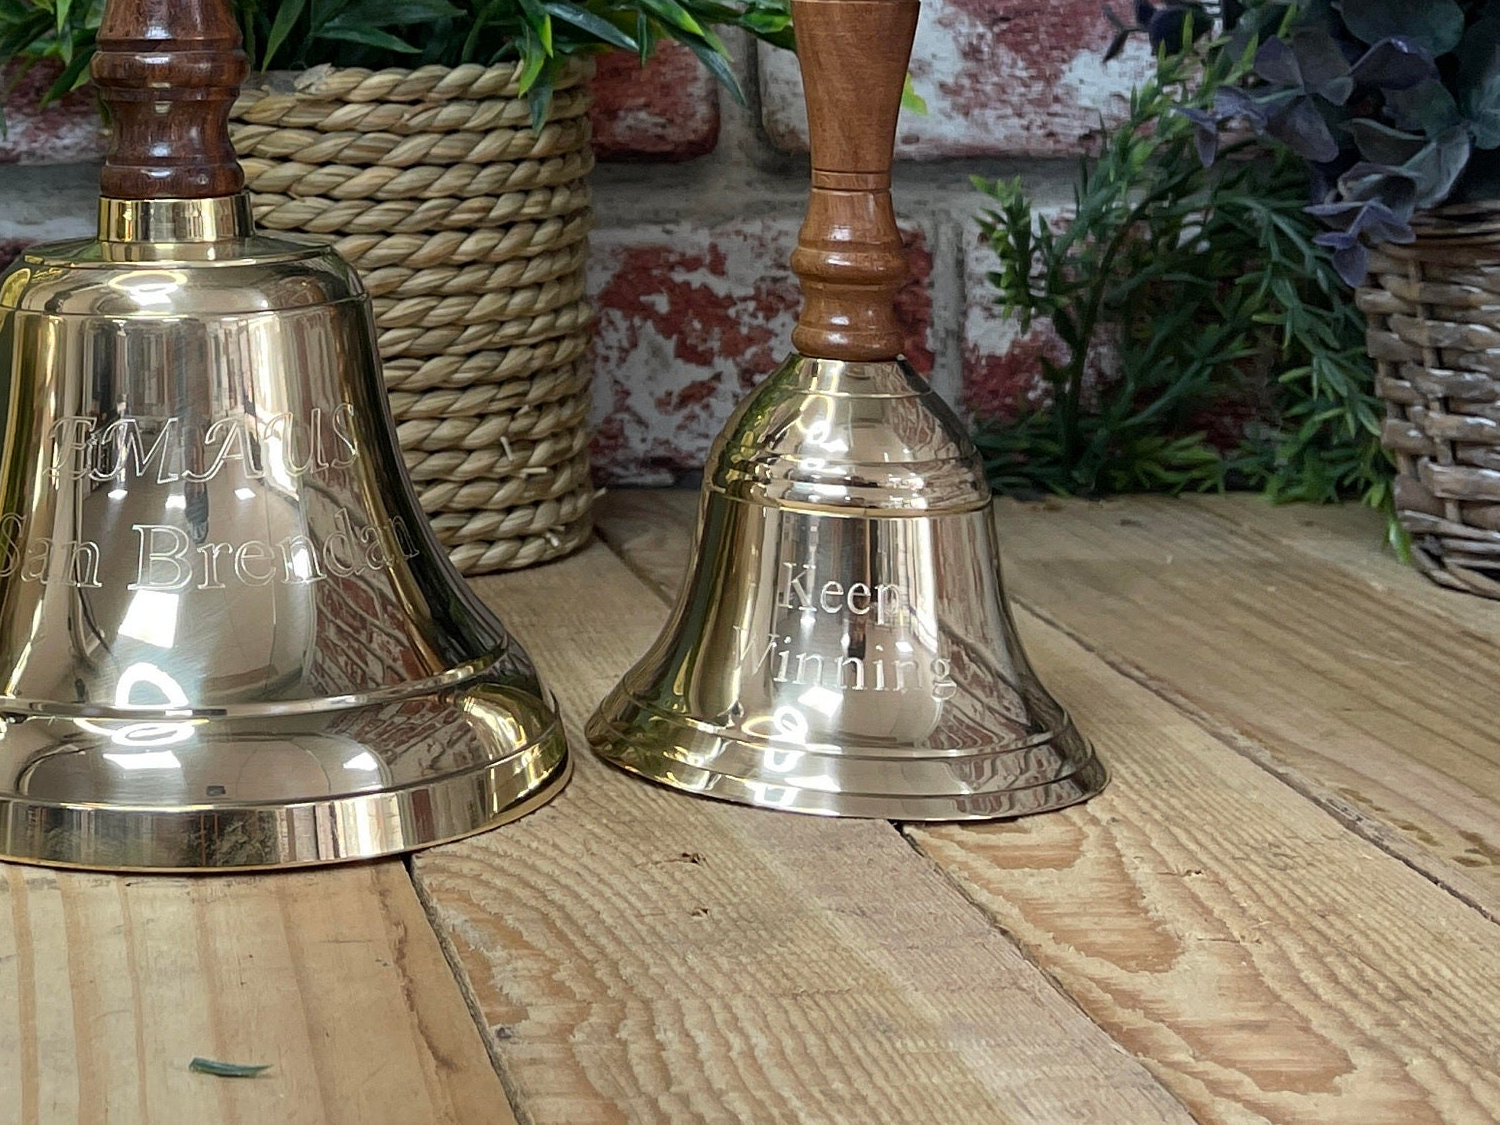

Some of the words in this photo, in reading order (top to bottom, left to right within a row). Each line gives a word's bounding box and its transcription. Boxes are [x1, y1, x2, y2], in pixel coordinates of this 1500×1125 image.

[43, 403, 359, 485] EMAUS
[127, 507, 421, 591] Brendan
[778, 562, 902, 625] Keep
[733, 625, 958, 701] Winning
